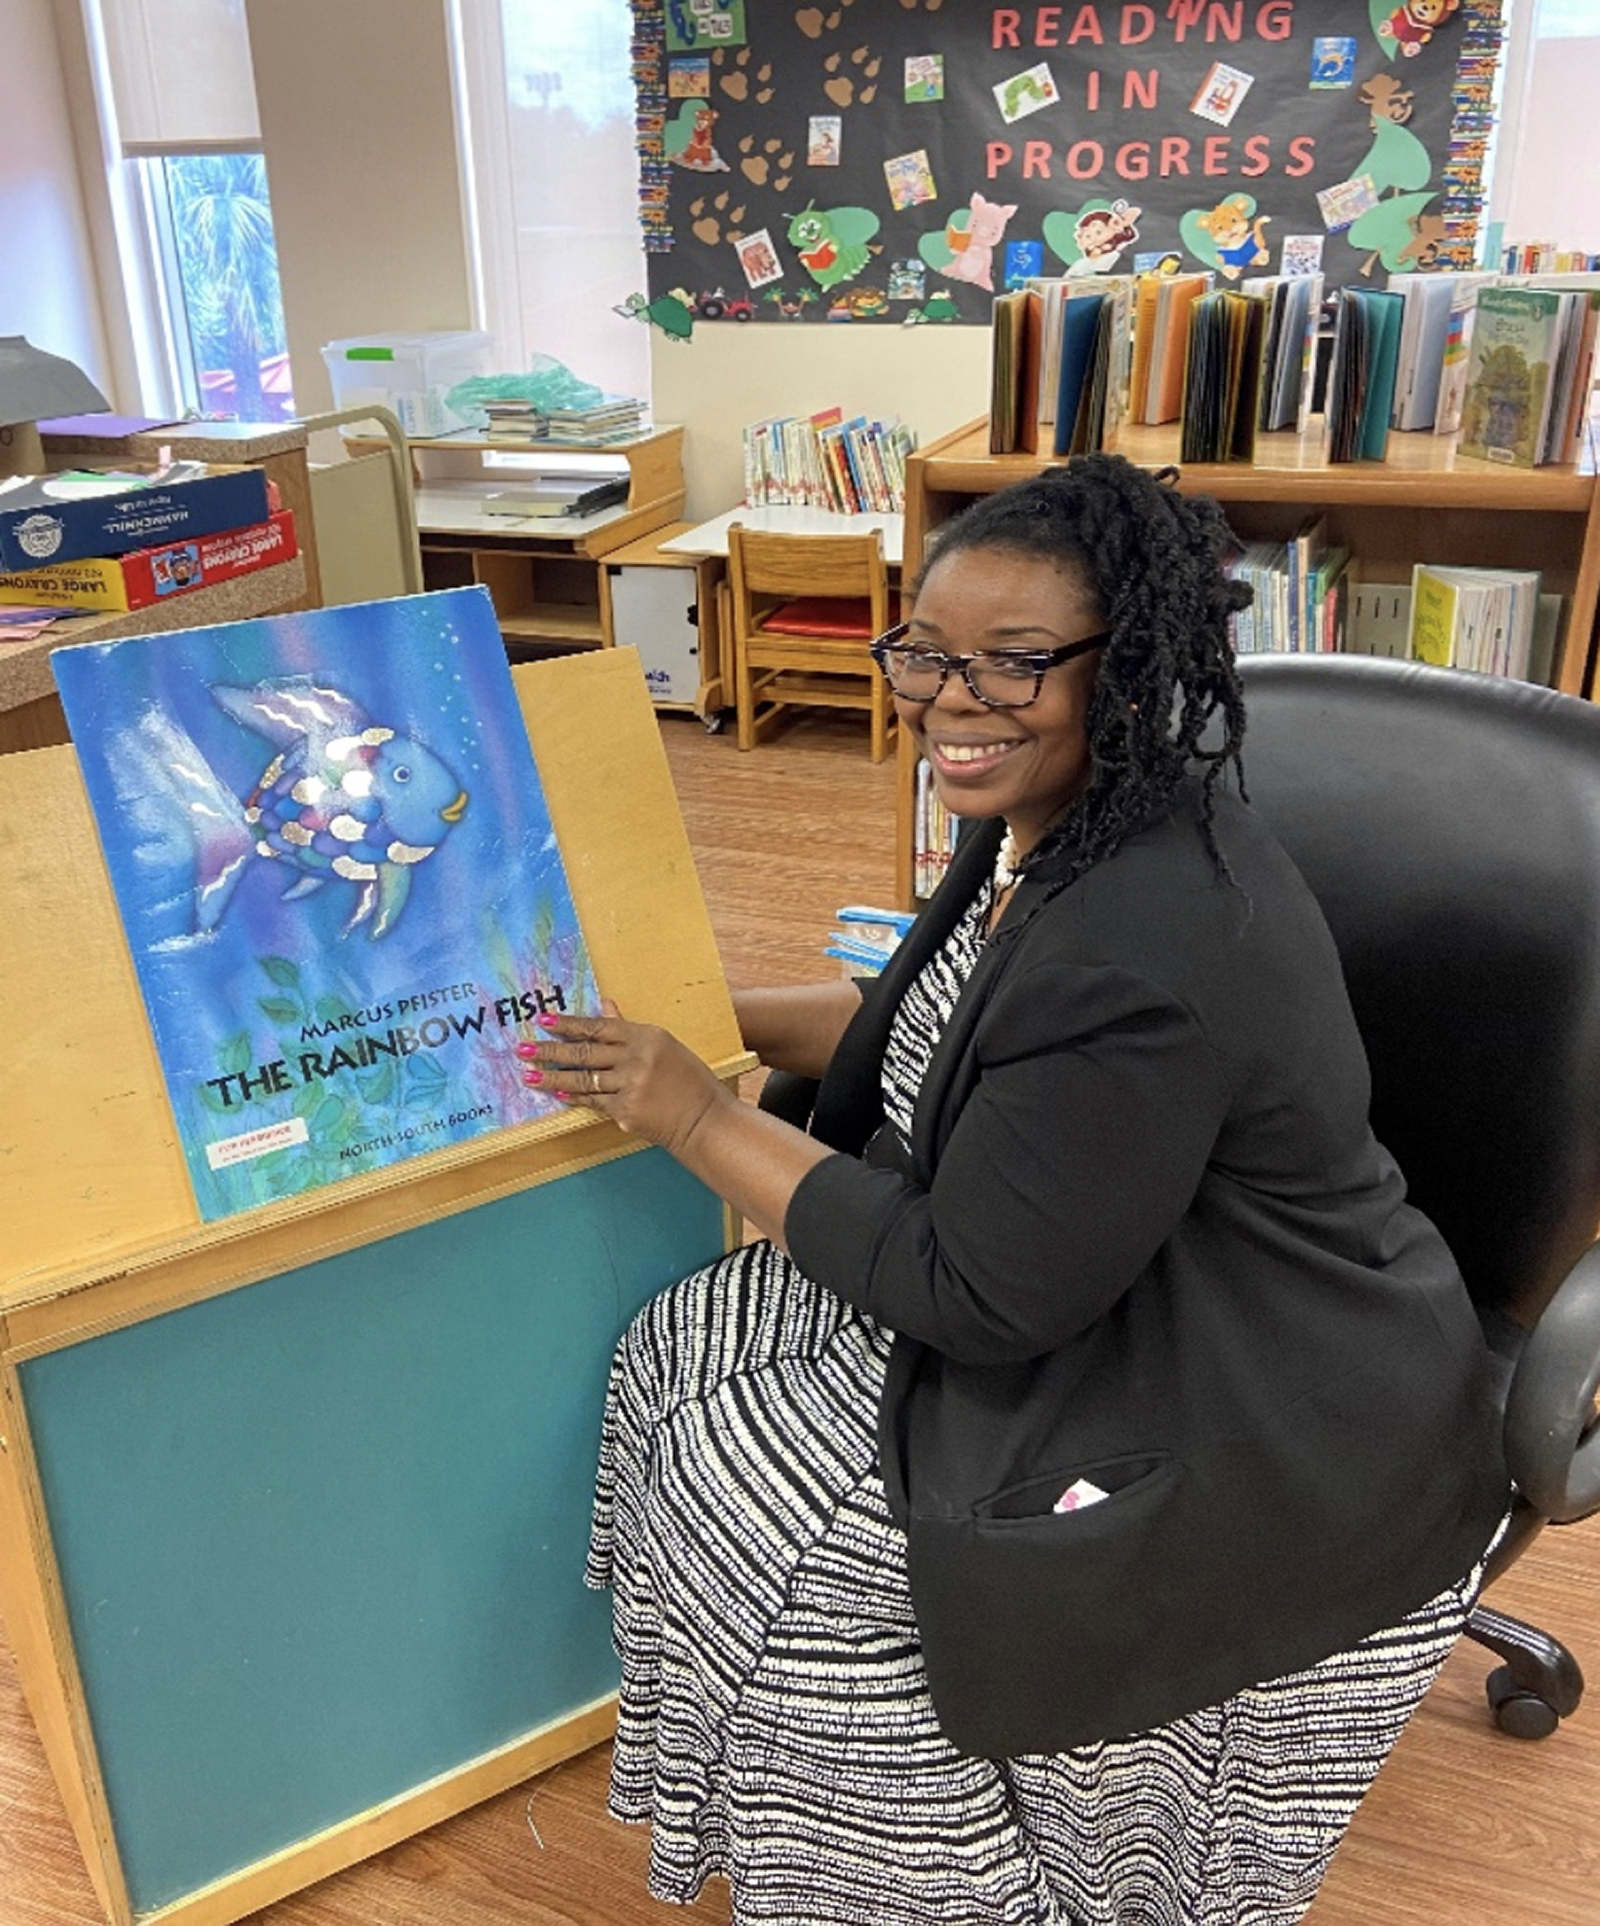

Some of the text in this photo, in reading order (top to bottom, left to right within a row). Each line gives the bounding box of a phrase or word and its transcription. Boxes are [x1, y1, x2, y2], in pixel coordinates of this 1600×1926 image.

[991, 0, 1294, 49] READING
[1087, 69, 1159, 111] IN
[986, 135, 1316, 180] PROGRESS
[203, 544, 249, 570] CRAYONS
[248, 535, 284, 559] LARGE
[63, 577, 107, 593] LARGE
[300, 982, 477, 1043] MARCUS PFISTER
[207, 984, 568, 1106] THE RAINBOW FISH
[448, 1104, 494, 1129] BOOKS
